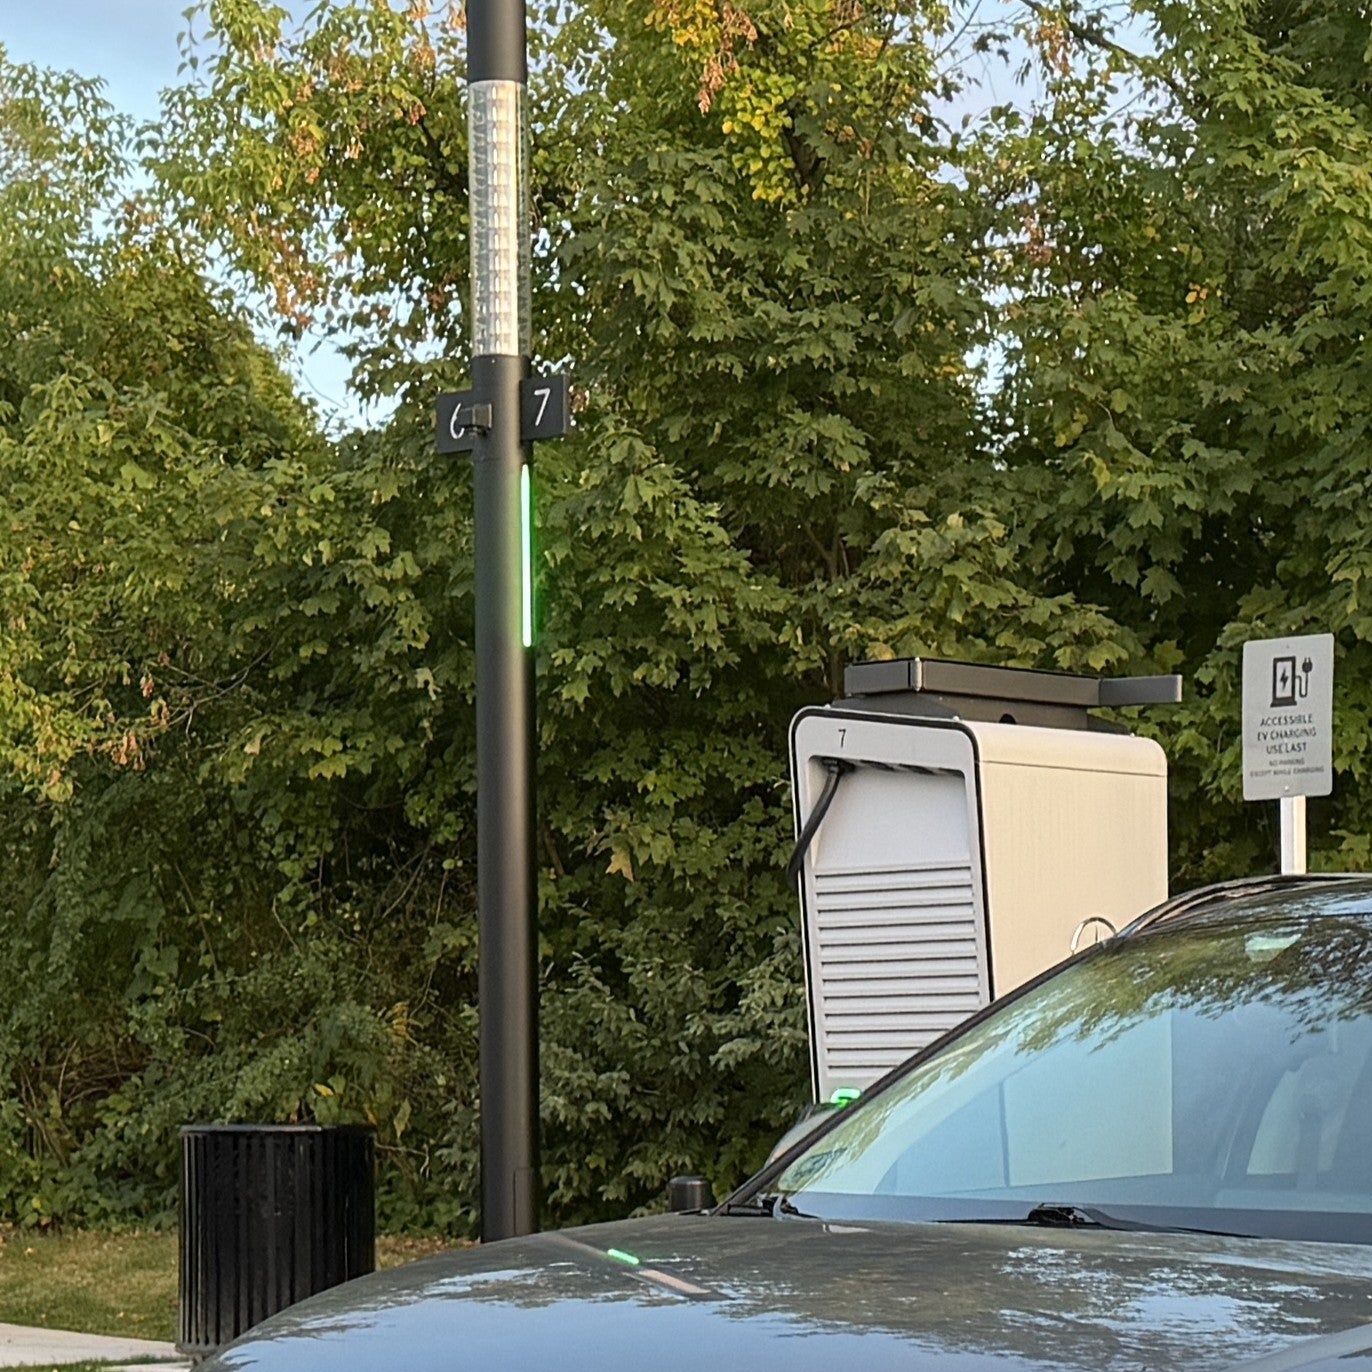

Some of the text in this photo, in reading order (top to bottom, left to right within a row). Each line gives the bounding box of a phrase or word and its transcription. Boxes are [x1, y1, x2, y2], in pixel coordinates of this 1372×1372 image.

[534, 388, 550, 426] 7
[1260, 713, 1312, 727] ACCESSIBLE
[838, 728, 847, 749] 7
[1257, 726, 1317, 741] EV CHARGING
[1266, 742, 1306, 754] USE LAST
